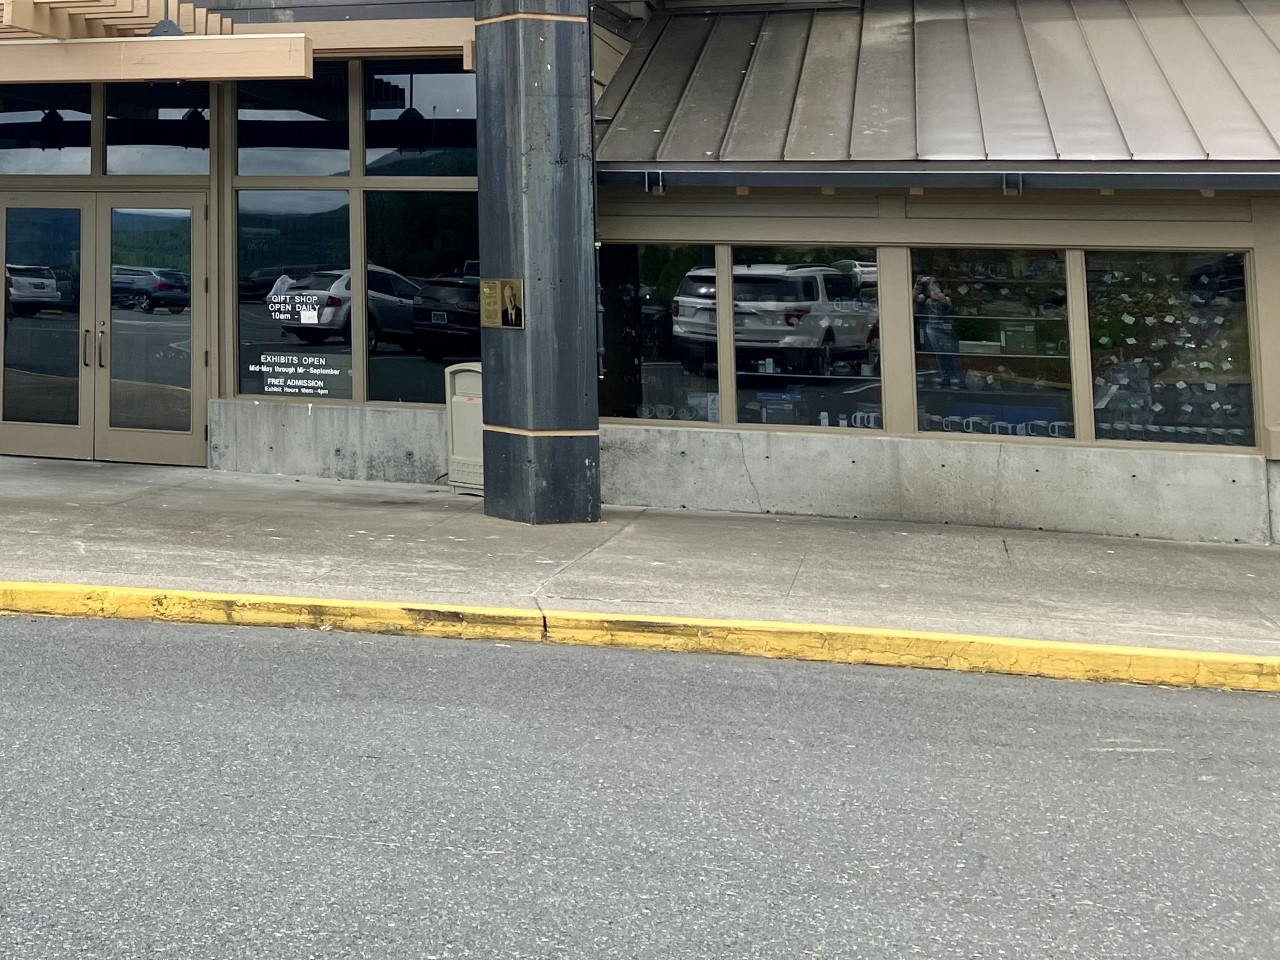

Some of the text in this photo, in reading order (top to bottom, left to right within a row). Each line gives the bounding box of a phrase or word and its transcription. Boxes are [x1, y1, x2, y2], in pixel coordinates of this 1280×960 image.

[271, 295, 318, 303] GIFT SHOP
[268, 303, 320, 312] OPEN DAILY
[271, 311, 291, 320] 10am
[260, 355, 326, 365] EXHIBITS OPEN
[249, 364, 273, 373] Mid-May
[274, 365, 296, 374] through
[267, 378, 324, 388] FREE ADMISSION
